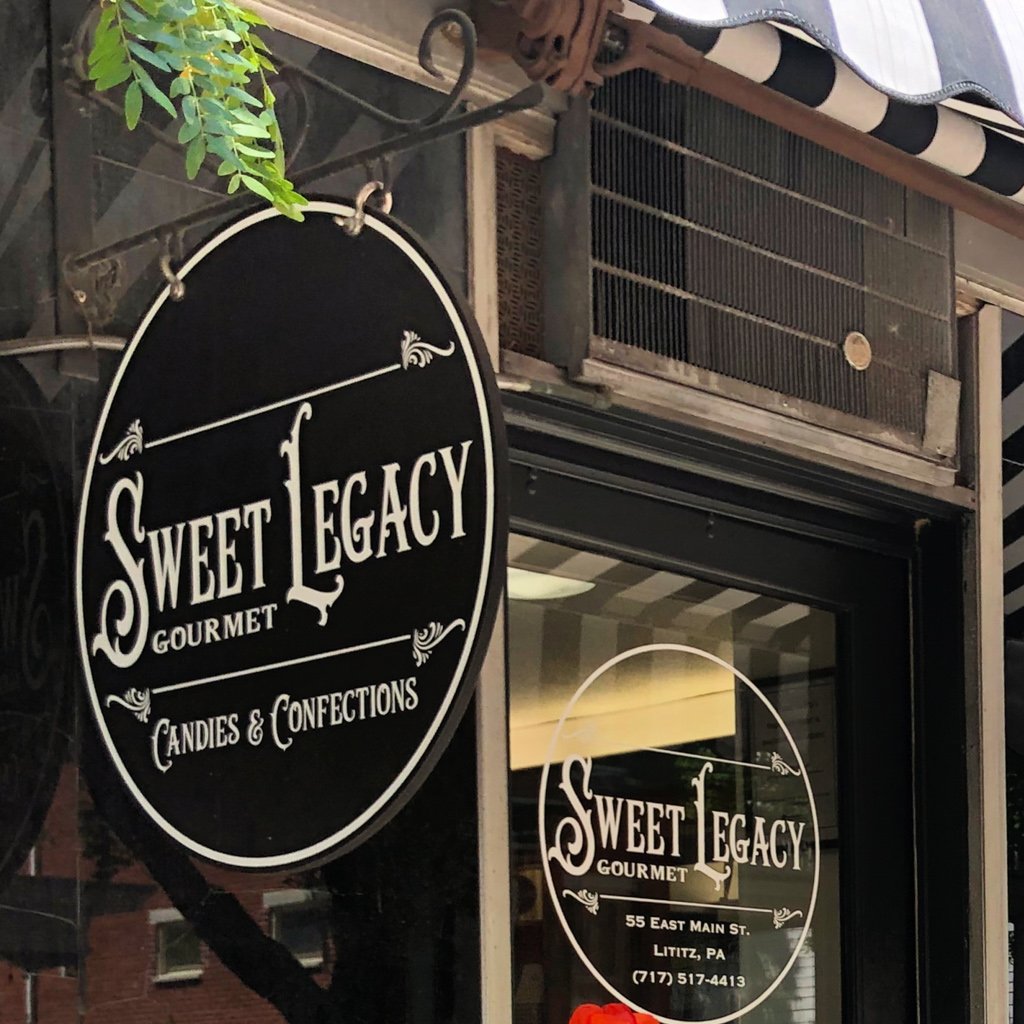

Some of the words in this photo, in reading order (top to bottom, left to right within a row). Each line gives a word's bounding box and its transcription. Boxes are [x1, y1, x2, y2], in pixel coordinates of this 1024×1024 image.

[93, 470, 272, 669] SWEET
[280, 402, 473, 627] LEGACY
[151, 603, 278, 655] GOURMET
[151, 713, 240, 773] CANDIES
[247, 709, 264, 747] &
[270, 677, 420, 751] CONFECTIONS
[548, 753, 685, 877] SWEET
[691, 761, 806, 892] LEGACY
[596, 858, 688, 884] GOURMET
[625, 914, 646, 929] 55
[650, 916, 686, 931] EAST
[689, 919, 725, 935] MAIN
[729, 922, 751, 936] ST.
[706, 947, 726, 961] PA
[632, 970, 673, 986] (717)
[677, 972, 746, 988] 517-4413
